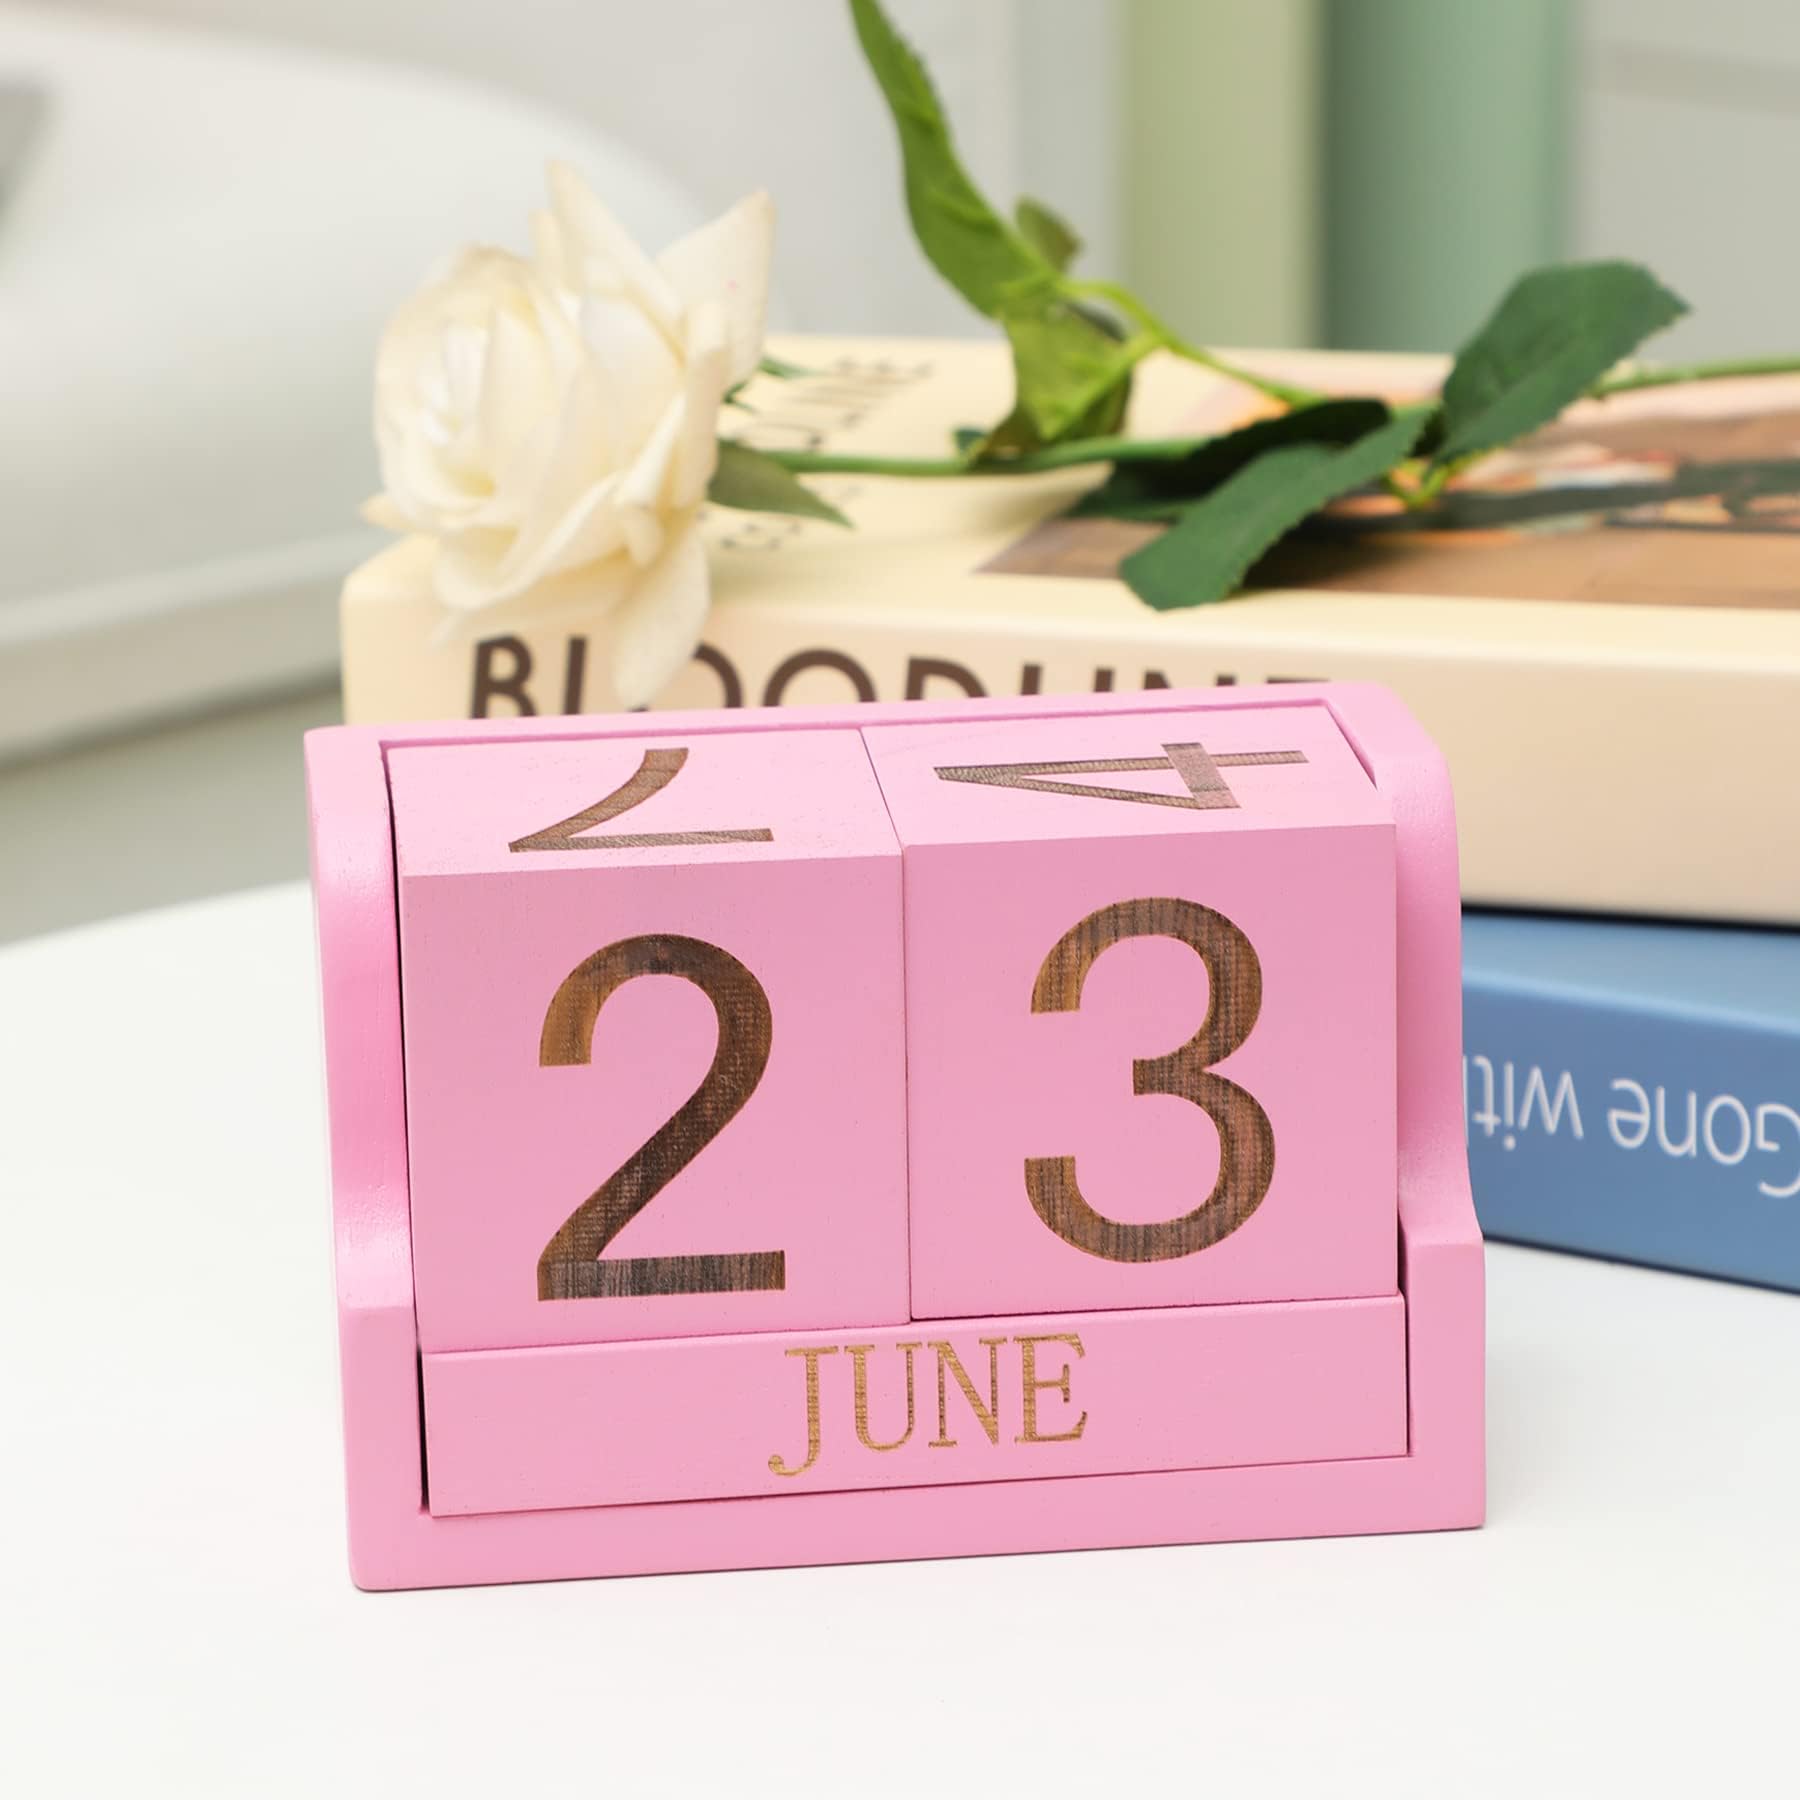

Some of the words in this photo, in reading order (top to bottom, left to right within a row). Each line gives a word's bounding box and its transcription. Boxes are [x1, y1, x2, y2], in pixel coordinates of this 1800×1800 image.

[934, 742, 1308, 810] 4
[537, 933, 786, 1302] 2
[1024, 896, 1276, 1264] 3
[1462, 1053, 1585, 1152] wit
[1607, 1077, 1800, 1199] Gone
[768, 1332, 1087, 1477] JUNE
